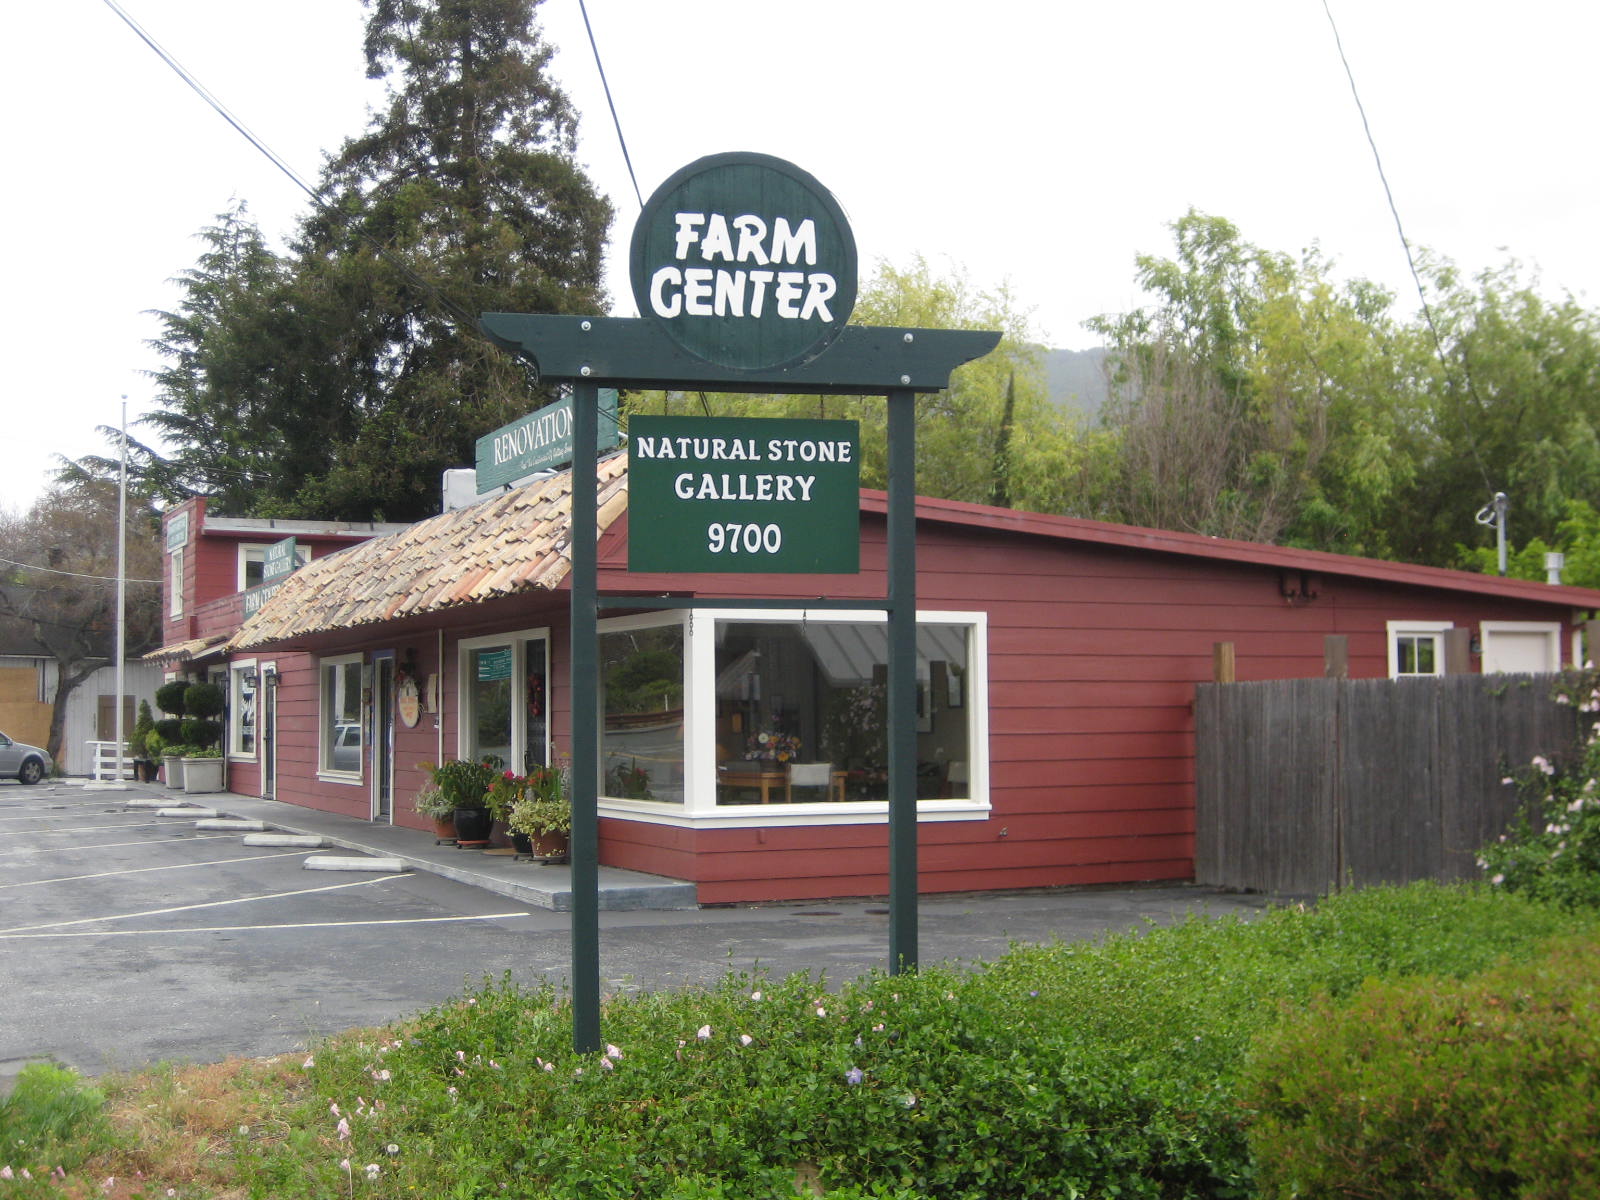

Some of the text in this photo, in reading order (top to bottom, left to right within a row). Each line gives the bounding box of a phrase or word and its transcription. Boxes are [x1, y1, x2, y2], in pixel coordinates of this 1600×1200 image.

[675, 212, 817, 265] FARM
[650, 266, 837, 322] CENTER
[637, 437, 852, 463] NATURAL STONE
[674, 473, 816, 501] GALLERY
[708, 523, 782, 554] 9700
[245, 590, 260, 613] FARM
